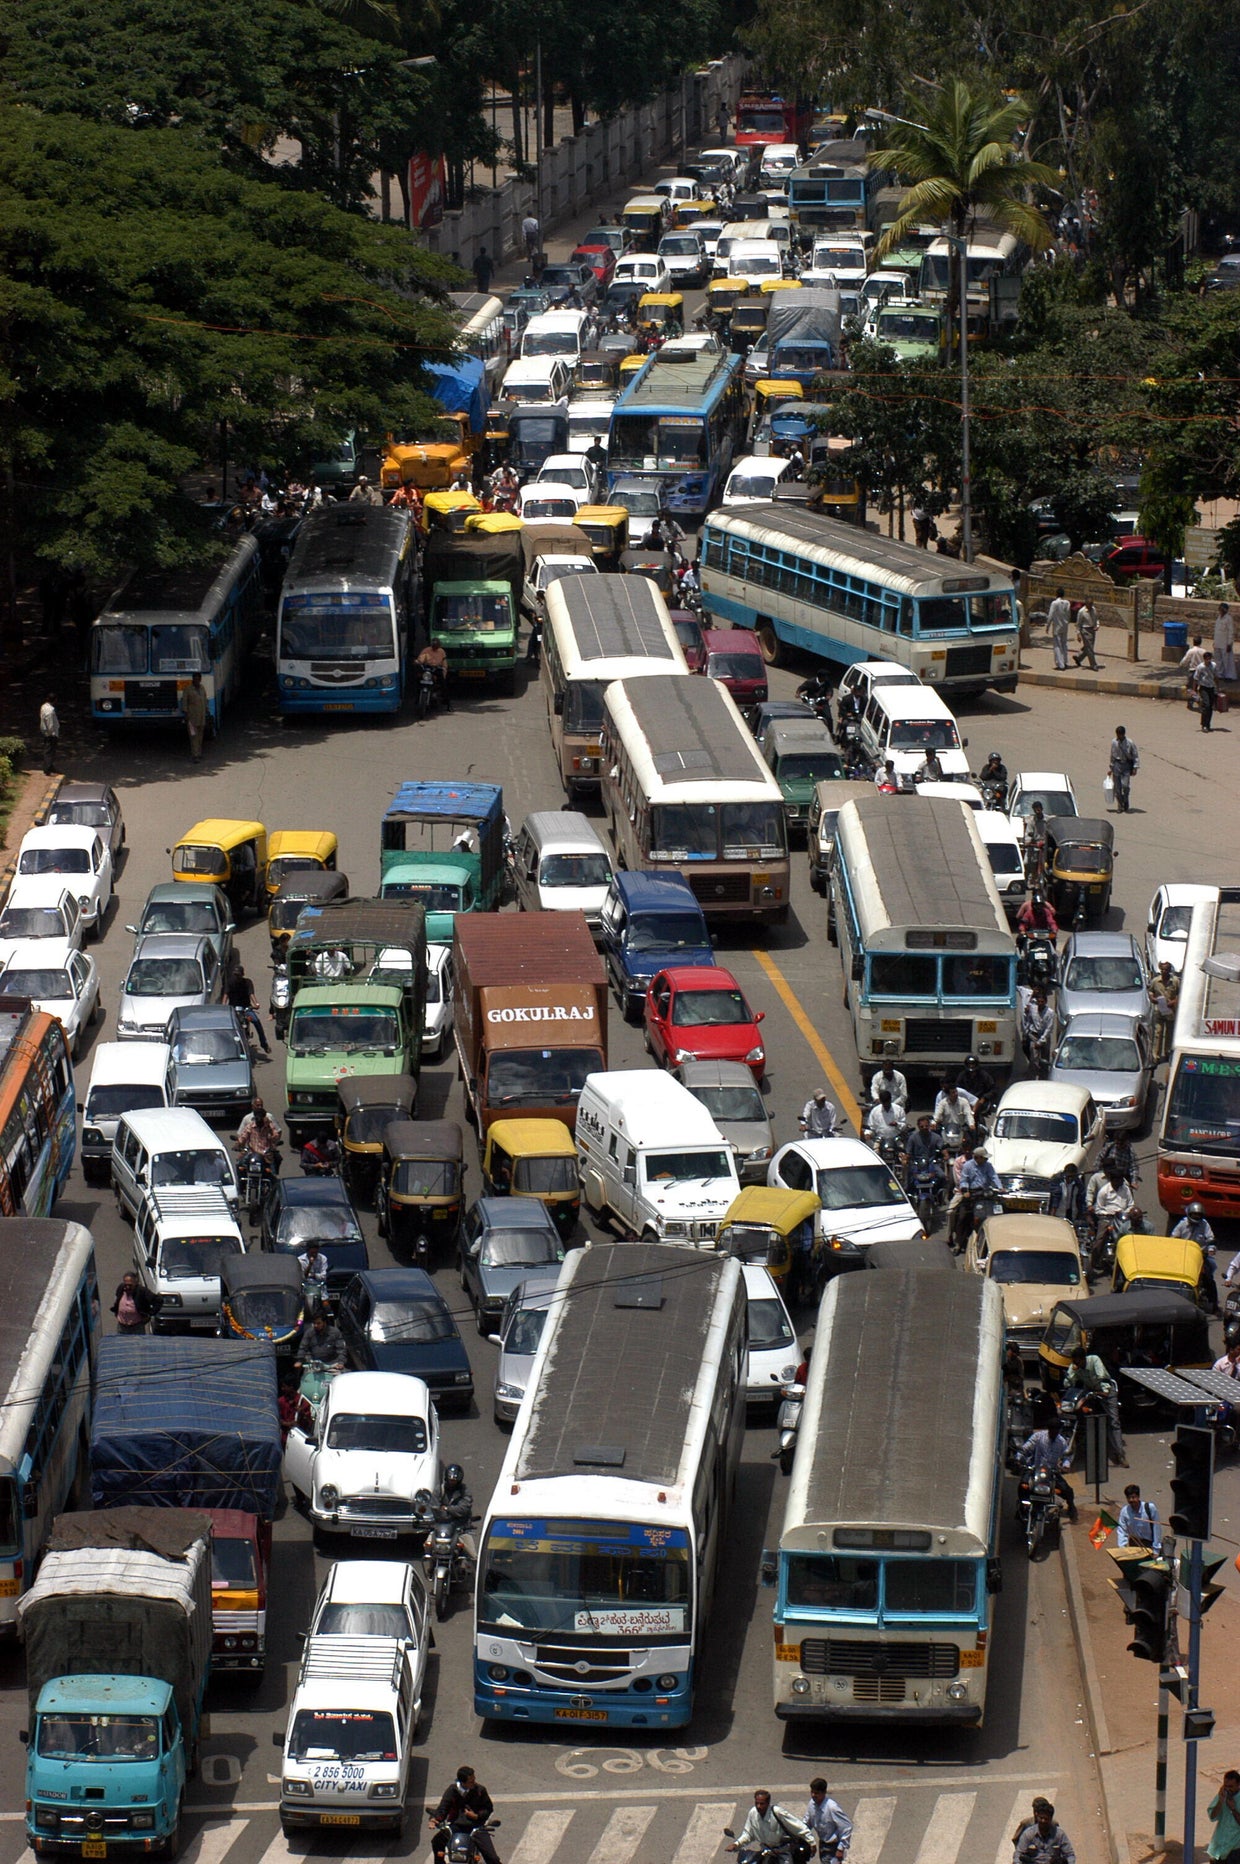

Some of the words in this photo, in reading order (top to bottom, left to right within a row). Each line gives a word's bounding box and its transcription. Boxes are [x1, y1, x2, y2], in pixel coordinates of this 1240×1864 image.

[487, 1006, 594, 1023] GOKULRAJ
[314, 1766, 321, 1778] 2
[322, 1767, 340, 1778] 856
[341, 1767, 365, 1779] 5000
[314, 1780, 339, 1790] CITY
[343, 1782, 368, 1791] TAXI
